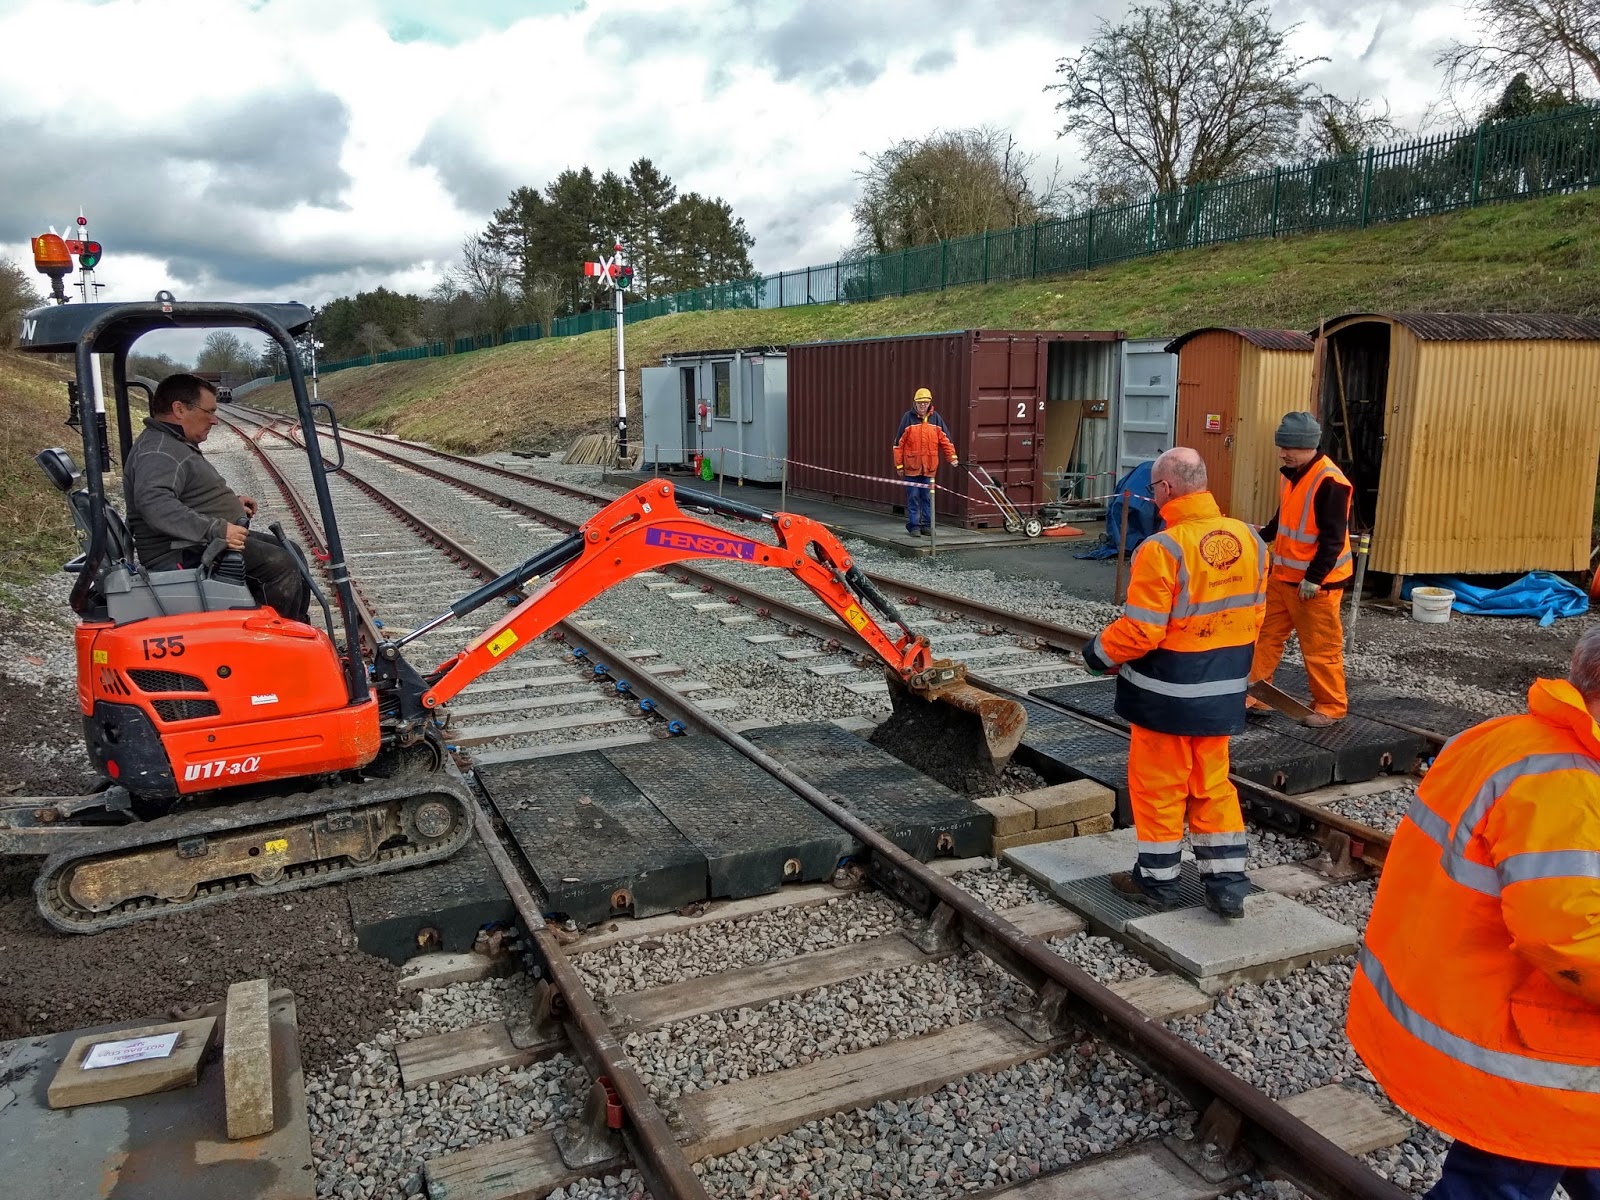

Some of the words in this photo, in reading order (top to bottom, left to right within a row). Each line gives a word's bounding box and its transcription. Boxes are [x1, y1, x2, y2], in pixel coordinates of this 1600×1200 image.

[20, 318, 37, 341] N
[1017, 402, 1026, 418] 2
[1039, 401, 1045, 411] 2
[659, 531, 743, 557] HENSON
[143, 635, 186, 661] 135
